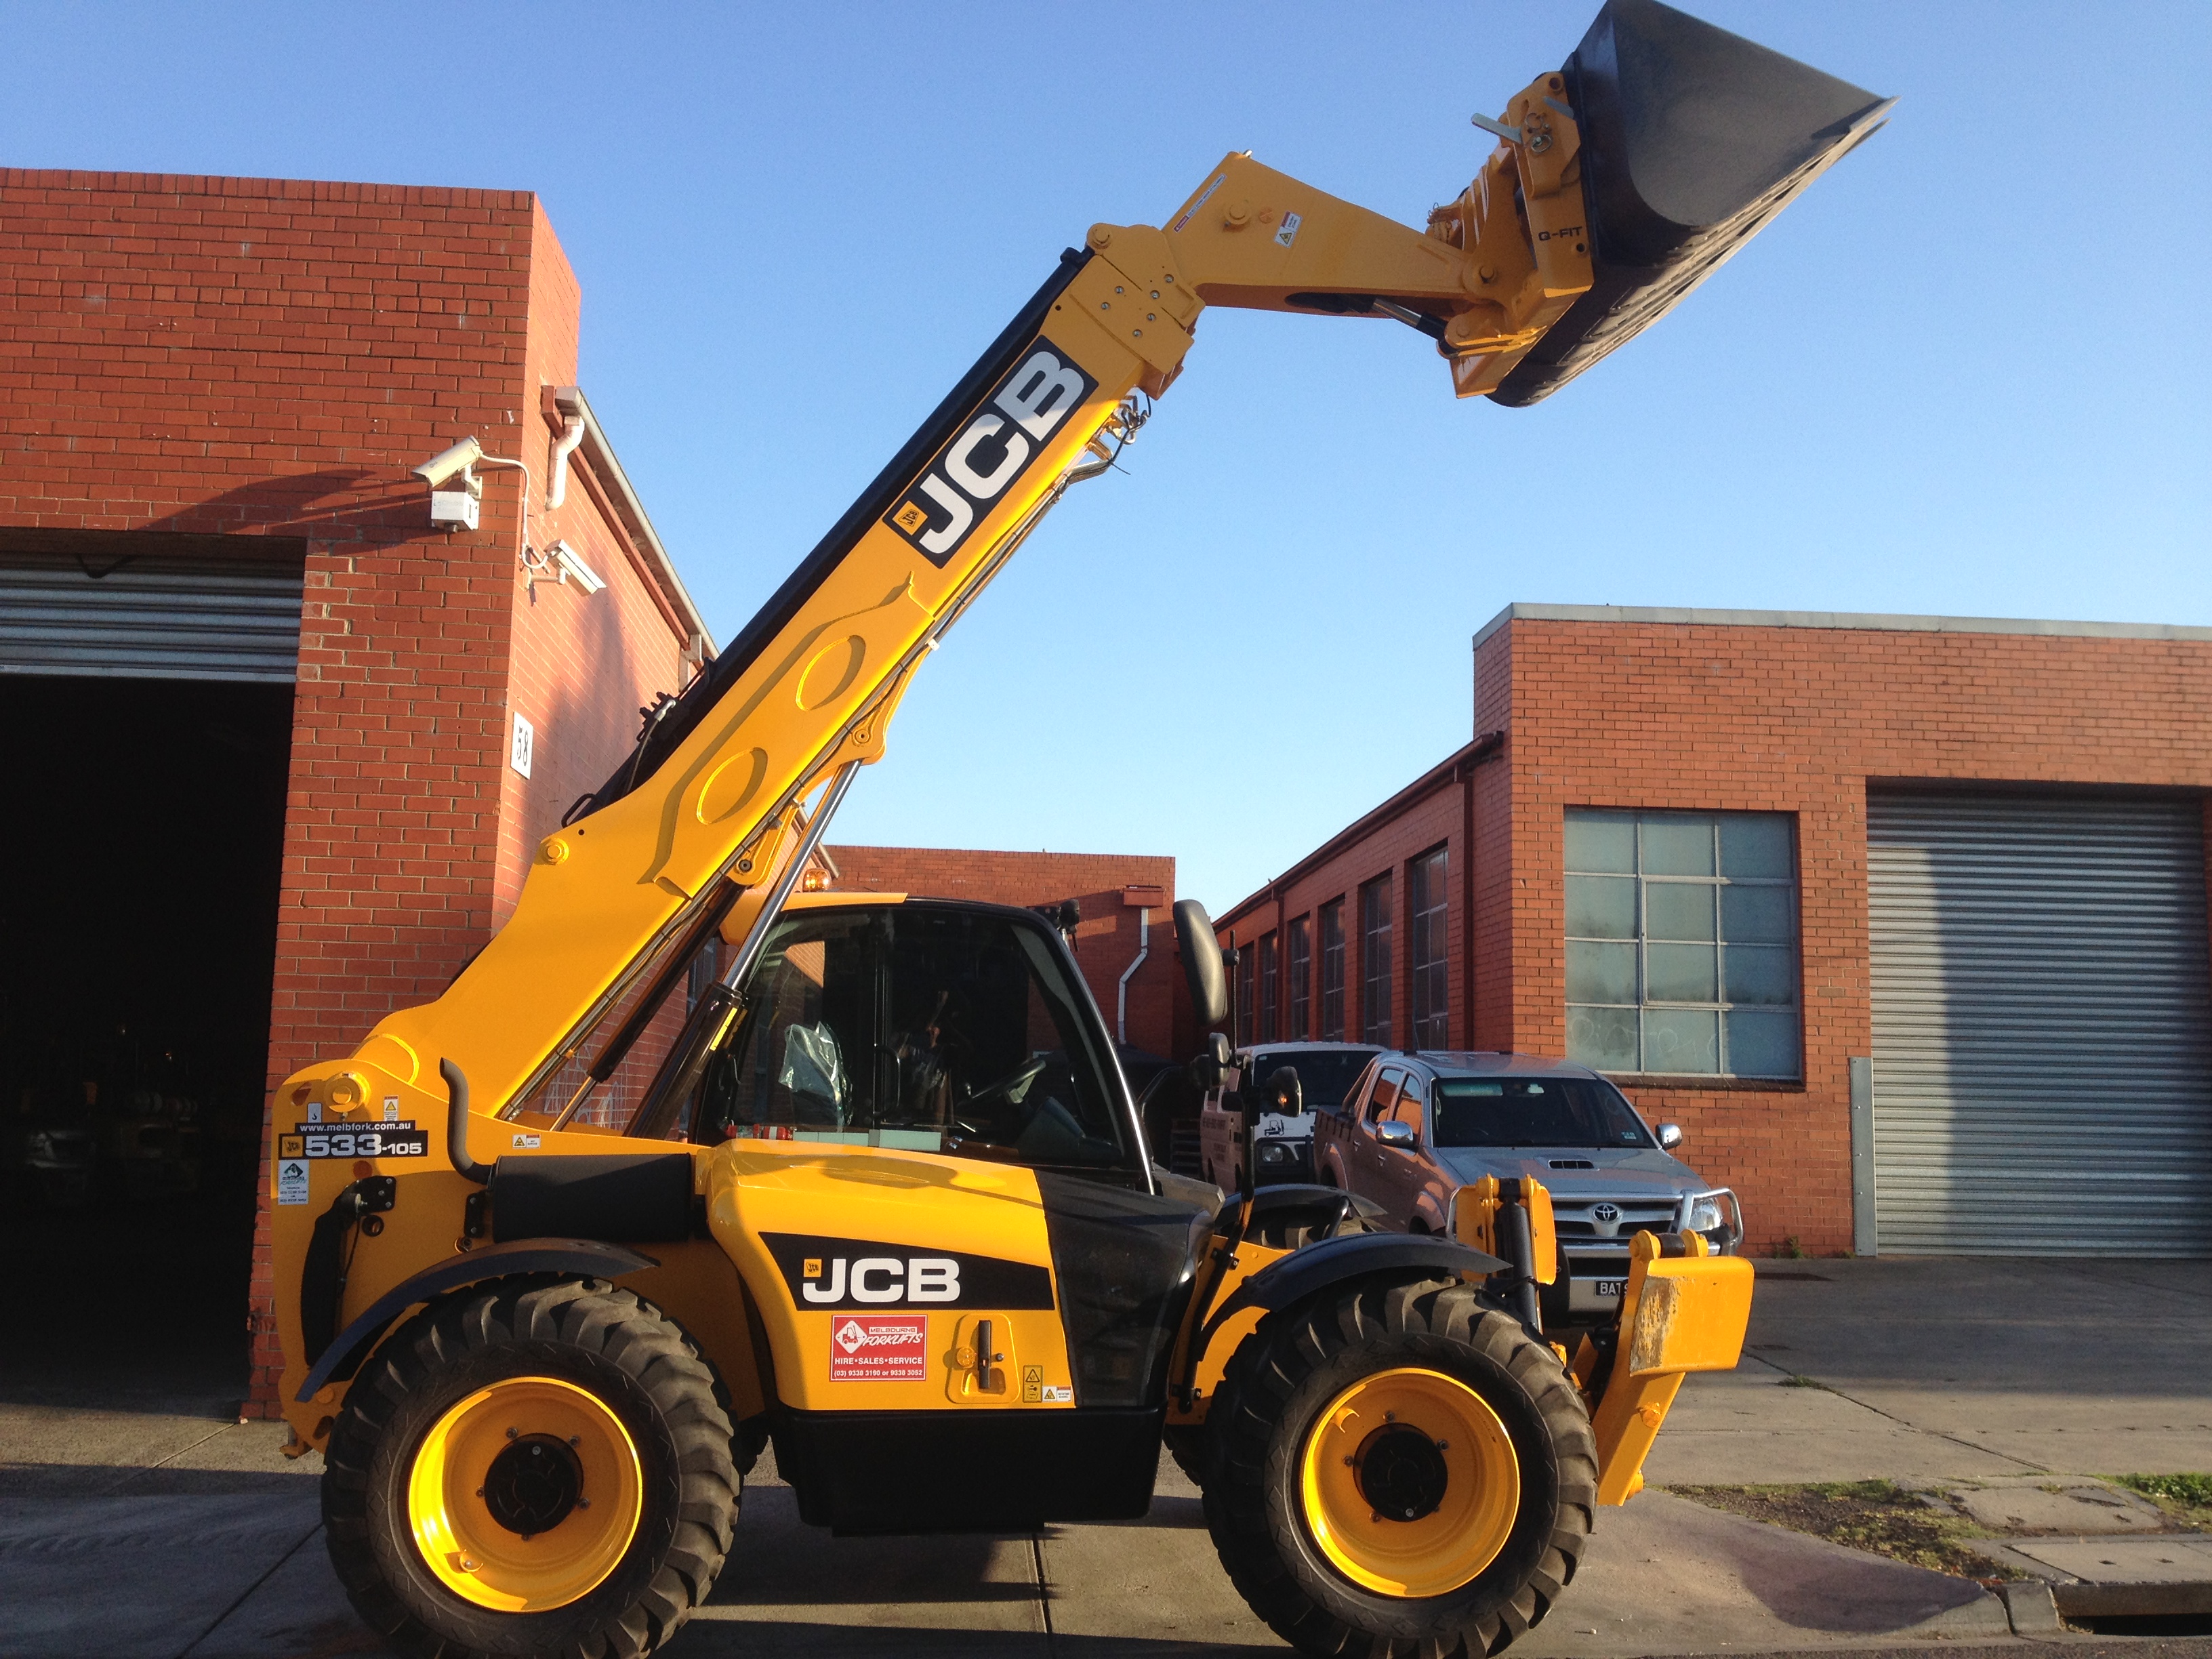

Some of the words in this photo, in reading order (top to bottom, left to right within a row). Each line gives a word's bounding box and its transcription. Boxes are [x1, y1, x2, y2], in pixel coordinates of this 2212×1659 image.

[1538, 226, 1582, 241] Q-FIT
[919, 351, 1084, 554] JCB
[902, 510, 918, 525] JCB
[517, 725, 529, 766] 58
[300, 1122, 411, 1132] www.melbfork.com.au
[305, 1134, 422, 1157] 533-105
[802, 1258, 960, 1303] JCB
[862, 1333, 924, 1347] FORKLIFTS
